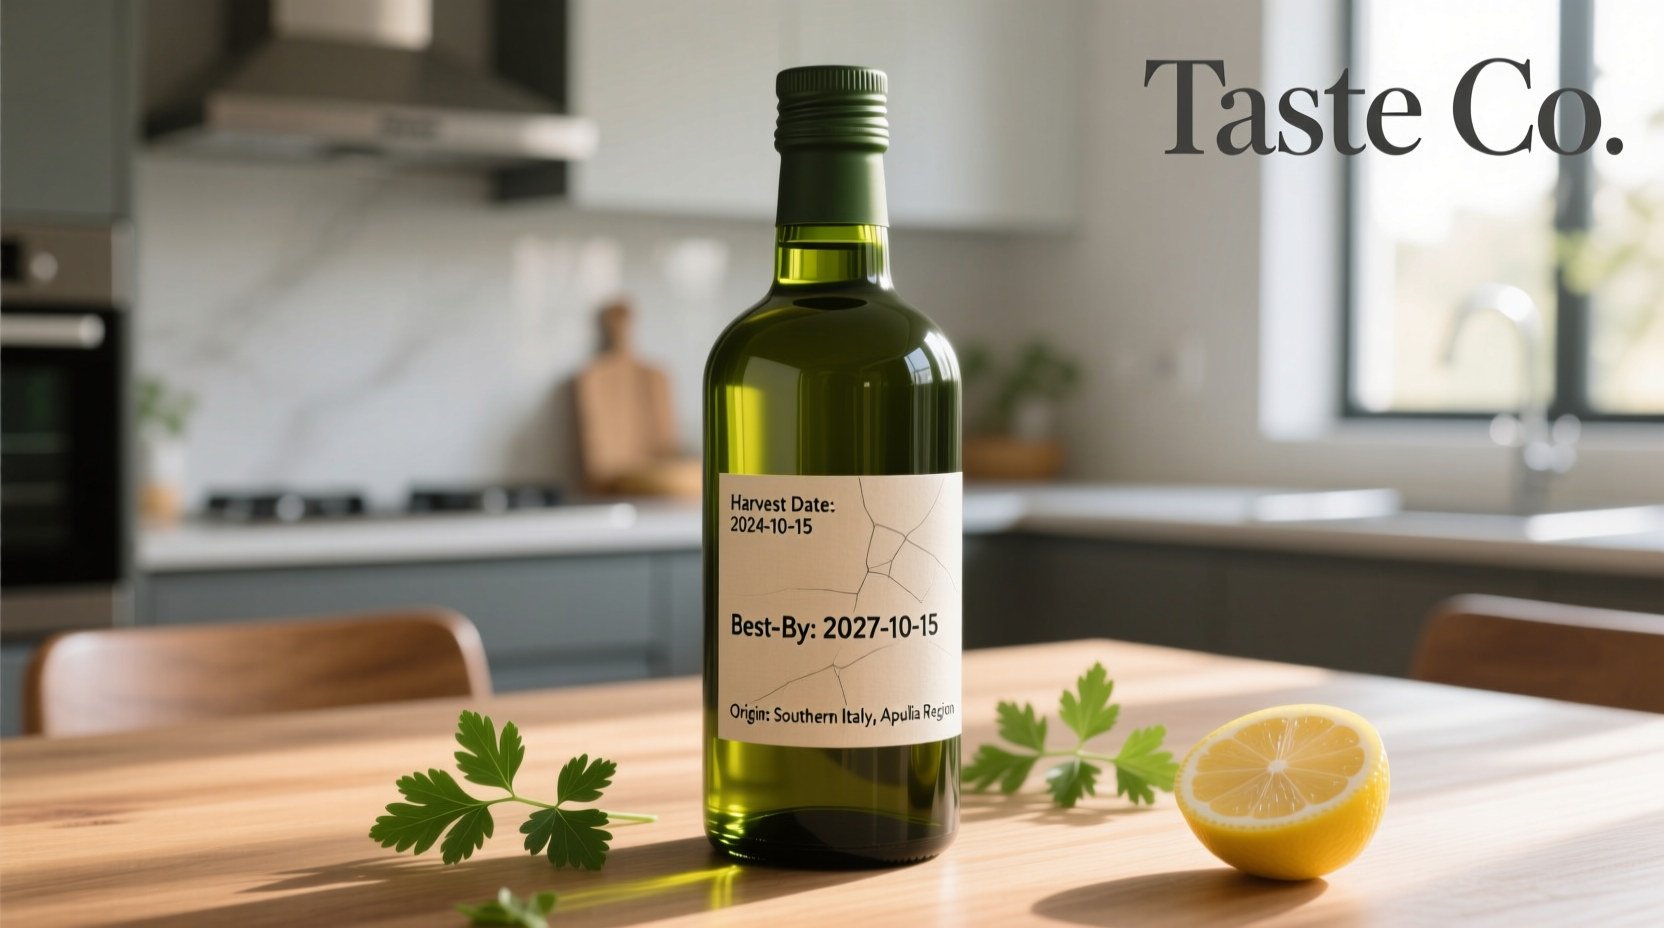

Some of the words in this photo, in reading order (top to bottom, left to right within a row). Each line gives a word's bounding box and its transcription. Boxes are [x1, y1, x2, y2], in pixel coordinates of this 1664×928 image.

[731, 494, 786, 512] Harvest
[791, 496, 836, 513] Date:
[730, 516, 813, 535] 2024-10-15
[731, 613, 816, 645] Best-By:
[823, 613, 938, 639] 2027-10-15
[730, 703, 770, 724] Origin:
[774, 707, 838, 724] Southern
[842, 708, 877, 727] Italy,
